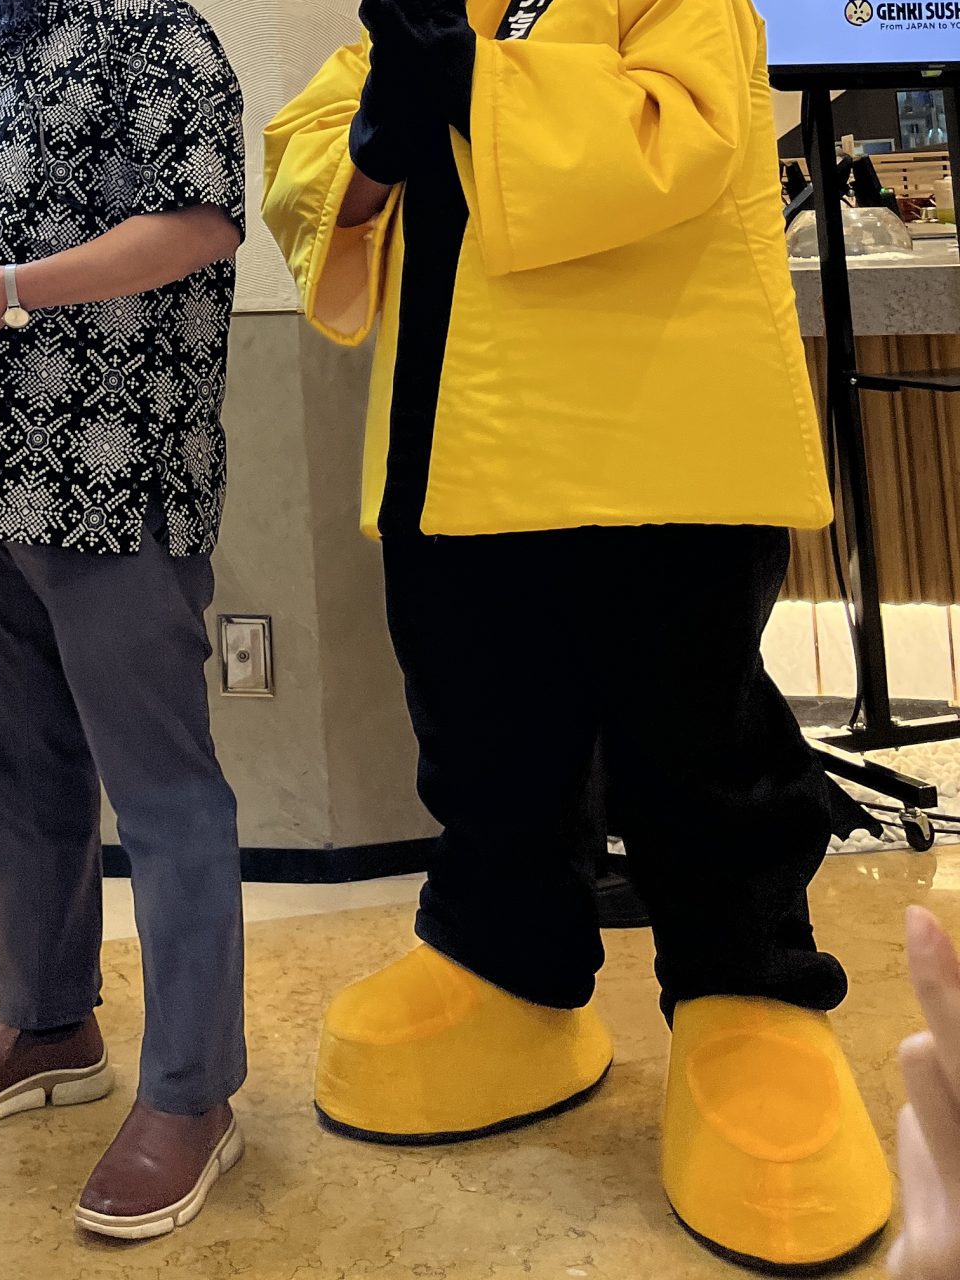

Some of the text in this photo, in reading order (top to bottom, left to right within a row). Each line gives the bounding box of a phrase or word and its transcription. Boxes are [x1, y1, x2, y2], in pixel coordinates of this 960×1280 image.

[876, 3, 923, 21] GENKI
[880, 23, 903, 31] From
[906, 22, 935, 30] JAPAN
[938, 21, 947, 30] to
